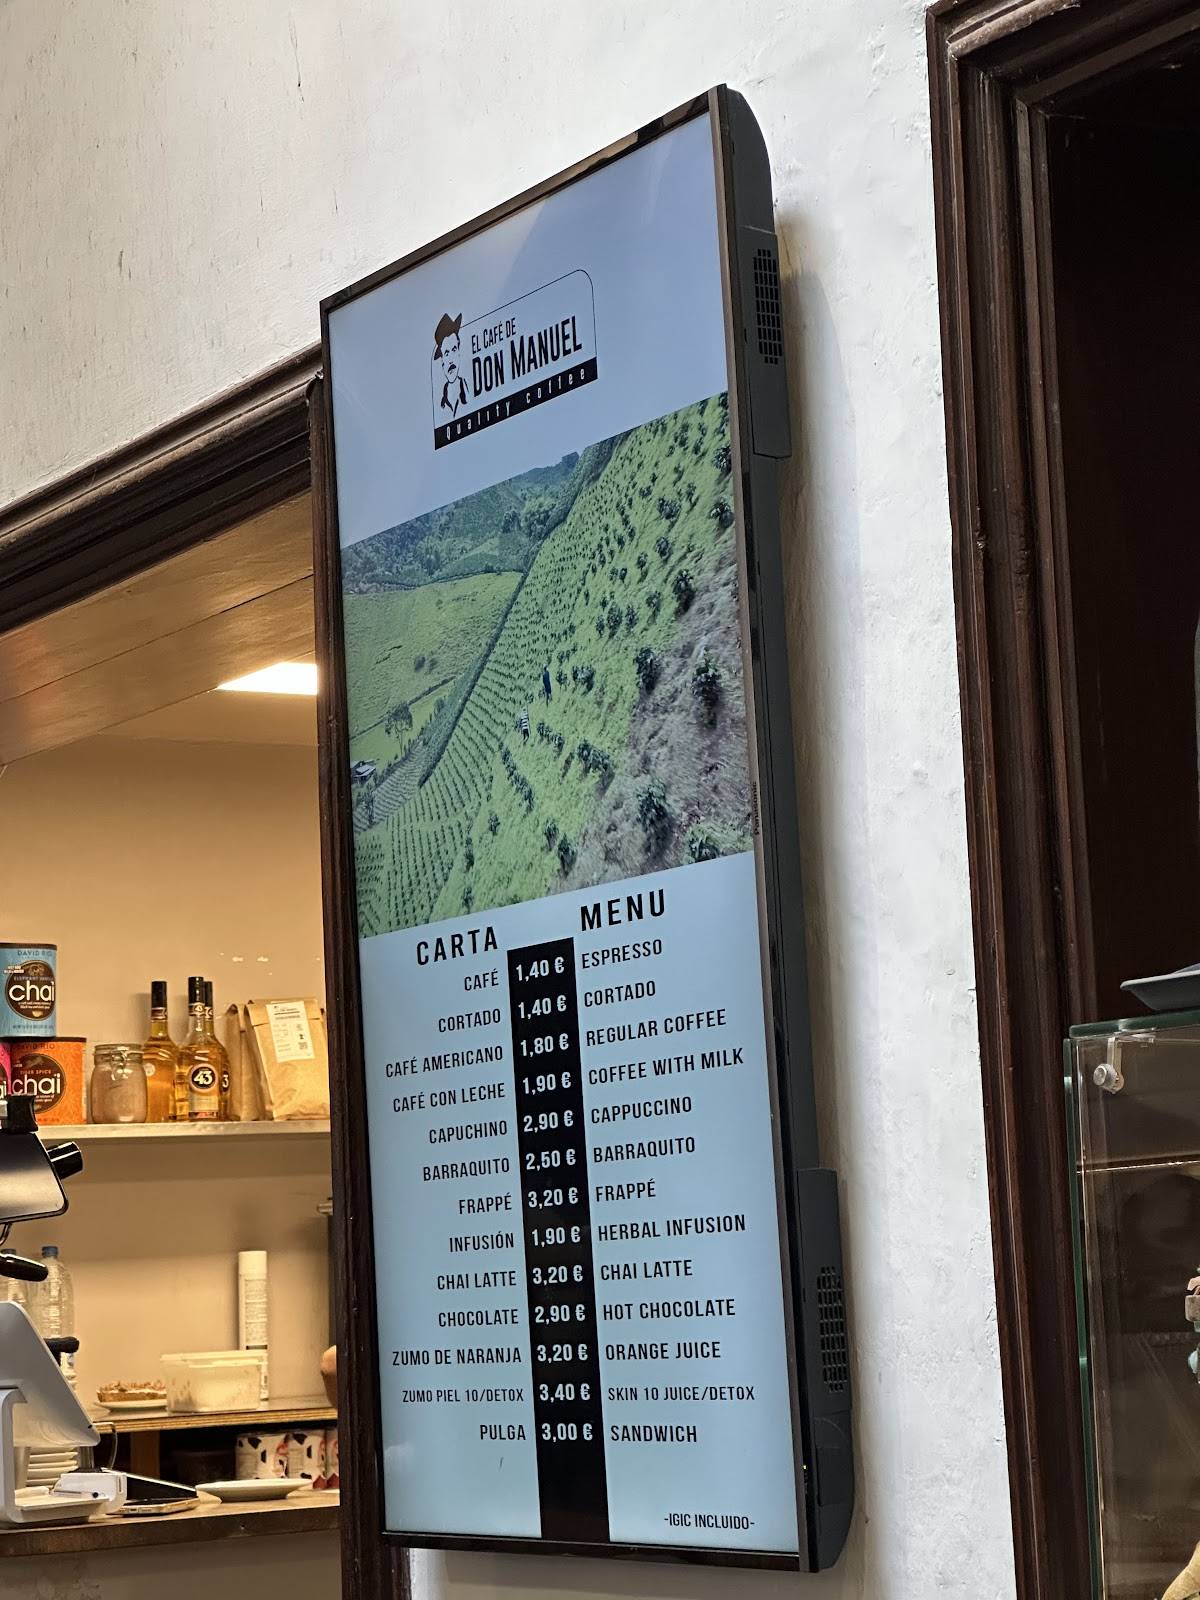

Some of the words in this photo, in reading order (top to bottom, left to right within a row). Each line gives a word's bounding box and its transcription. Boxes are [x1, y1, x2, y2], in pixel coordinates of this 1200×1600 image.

[472, 335, 481, 355] EL
[484, 321, 503, 349] CAFÉ
[506, 317, 516, 338] DE
[472, 350, 505, 397] DON
[510, 315, 582, 380] MANUEL
[526, 367, 584, 403] coffee
[580, 889, 666, 932] MENU
[416, 926, 499, 966] CARTA
[581, 939, 662, 969] ESPRESSO
[464, 968, 500, 991] CAFÉ
[516, 959, 549, 982] 1,40
[554, 956, 565, 974] €
[584, 980, 656, 1008] CORTADO
[518, 997, 552, 1019] 1,40
[556, 994, 568, 1012] €
[438, 1008, 501, 1033] CORTADO
[586, 1020, 658, 1046] REGULAR
[664, 1008, 727, 1034] COFFEE
[520, 1035, 554, 1058] 1,80
[558, 1032, 569, 1051] €
[386, 1056, 418, 1078] CAFÉ
[422, 1046, 503, 1073] AMERICANO
[588, 1062, 647, 1085] COFFEE
[653, 1054, 695, 1078] WITH
[701, 1048, 744, 1070] MILK
[193, 1070, 213, 1085] 43
[522, 1074, 556, 1096] 1,90
[561, 1071, 572, 1089] €
[392, 1092, 426, 1113] CAFÉ
[430, 1089, 457, 1108] CON
[461, 1082, 506, 1104] LECHE
[591, 1096, 692, 1124] CAPPUCCINO
[429, 1120, 508, 1144] CAPUCHINO
[523, 1112, 558, 1134] 2,90
[563, 1110, 574, 1127] €
[526, 1151, 561, 1171] 2,50
[566, 1148, 576, 1166] €
[593, 1136, 696, 1163] BARRAQUITO
[422, 1158, 510, 1182] BARRAQUITO
[528, 1189, 563, 1210] 3,20
[568, 1187, 579, 1204] €
[596, 1179, 656, 1202] FRAPPÉ
[459, 1193, 512, 1214] FRAPPÉ
[531, 1228, 566, 1248] 1,90
[571, 1226, 581, 1244] €
[598, 1219, 661, 1241] HERBAL
[667, 1214, 746, 1236] INFUSION
[449, 1231, 514, 1252] INFUSIÓN
[437, 1274, 470, 1291] CHAI
[474, 1271, 517, 1288] LATTE
[532, 1267, 568, 1286] 3,20
[573, 1264, 583, 1282] €
[601, 1263, 638, 1281] CHAI
[644, 1259, 692, 1279] LATTE
[438, 1309, 519, 1328] CHOCOLATE
[534, 1306, 570, 1326] 2,90
[576, 1304, 586, 1322] €
[603, 1303, 633, 1320] HOT
[640, 1299, 736, 1319] CHOCOLATE
[392, 1350, 431, 1366] ZUMO
[435, 1349, 452, 1364] DE
[457, 1347, 522, 1364] NARANJA
[537, 1346, 572, 1364] 3,20
[578, 1343, 588, 1361] €
[606, 1342, 669, 1361] ORANGE
[676, 1341, 721, 1359] JUICE
[402, 1389, 432, 1402] ZUMO
[436, 1389, 460, 1402] PIEL
[465, 1388, 524, 1402] 10/DETOX
[539, 1385, 574, 1403] 3,40
[580, 1383, 591, 1401] €
[608, 1387, 638, 1401] SKIN
[644, 1387, 658, 1401] 10
[664, 1386, 755, 1401] JUICE/DETOX
[480, 1424, 526, 1441] PULGA
[541, 1424, 578, 1441] 3,00
[583, 1422, 592, 1441] €
[611, 1425, 698, 1442] SANDWICH
[664, 1512, 691, 1528] -IGIC
[695, 1514, 754, 1530] INCLUIDO-
